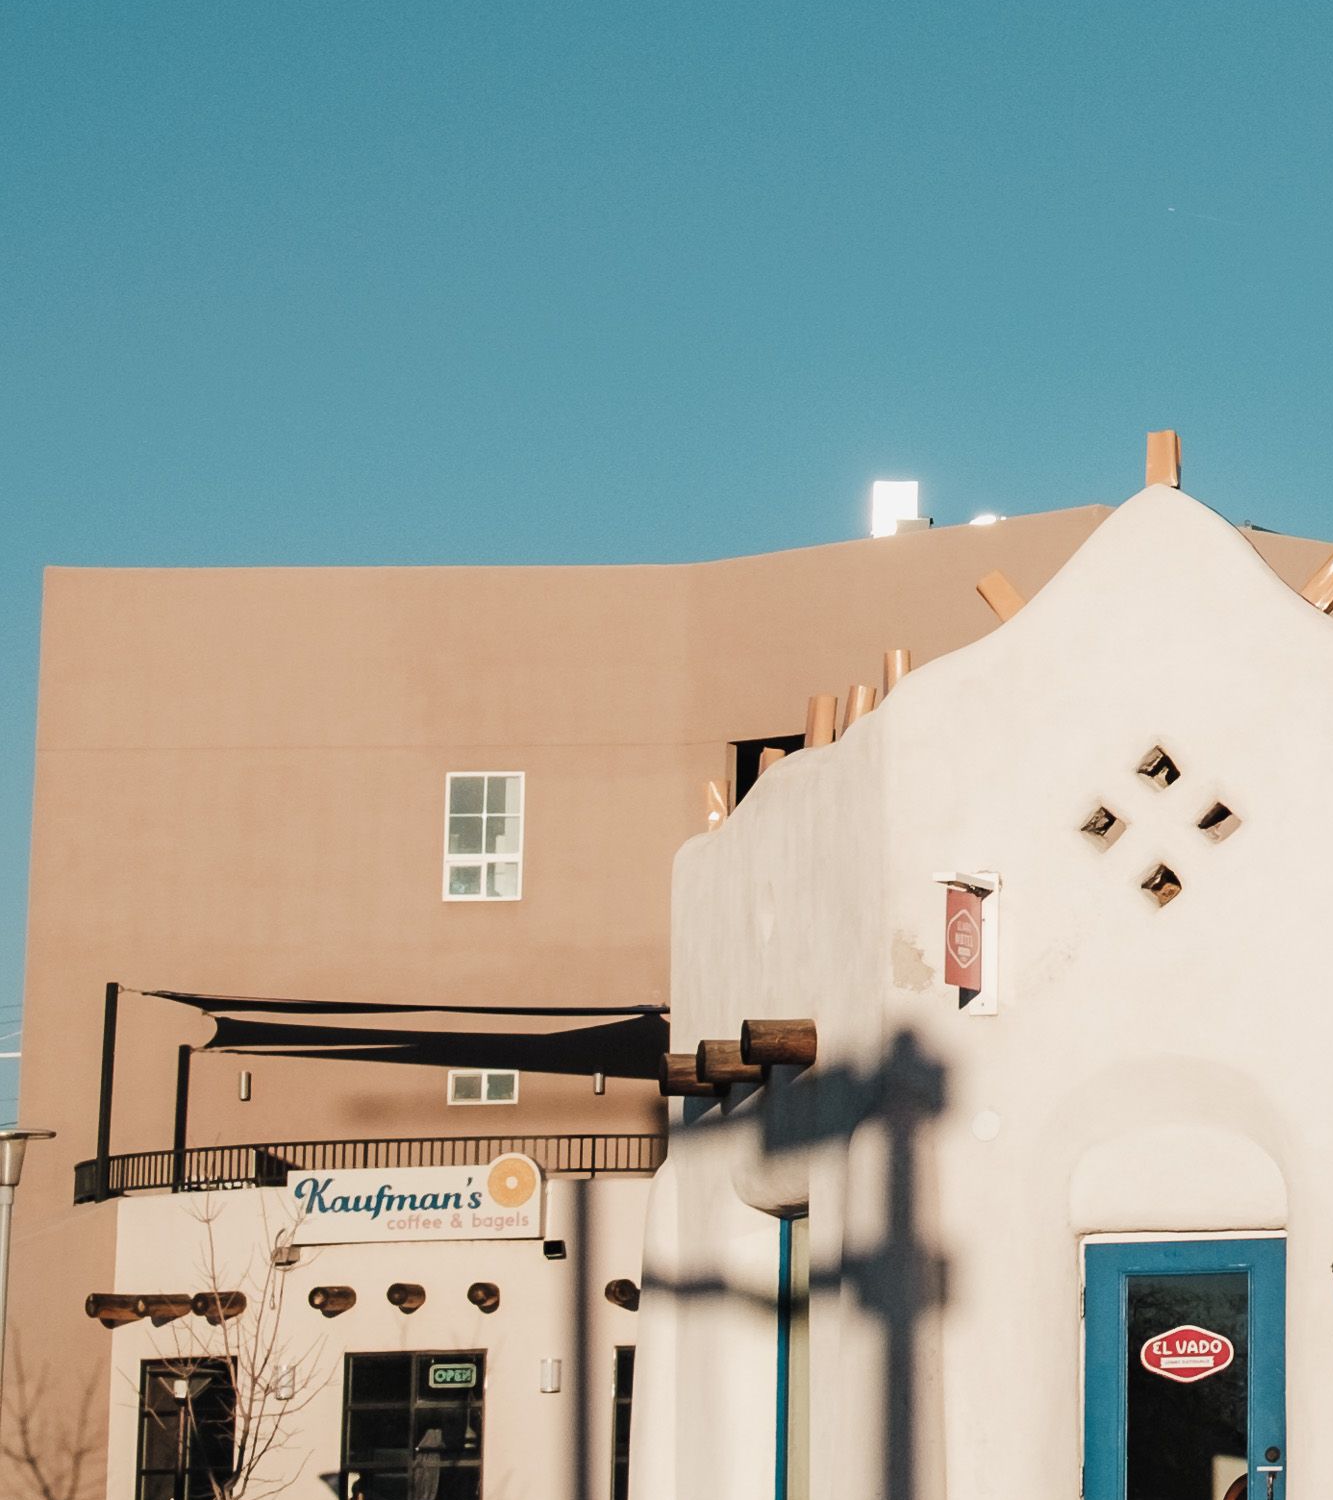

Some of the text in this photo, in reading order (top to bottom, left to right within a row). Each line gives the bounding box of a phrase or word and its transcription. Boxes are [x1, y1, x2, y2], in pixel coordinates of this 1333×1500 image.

[293, 1176, 483, 1221] Kaufman's
[386, 1211, 530, 1232] coffee & bagels
[1152, 1339, 1223, 1356] EL VADO
[434, 1369, 472, 1383] OPEN
